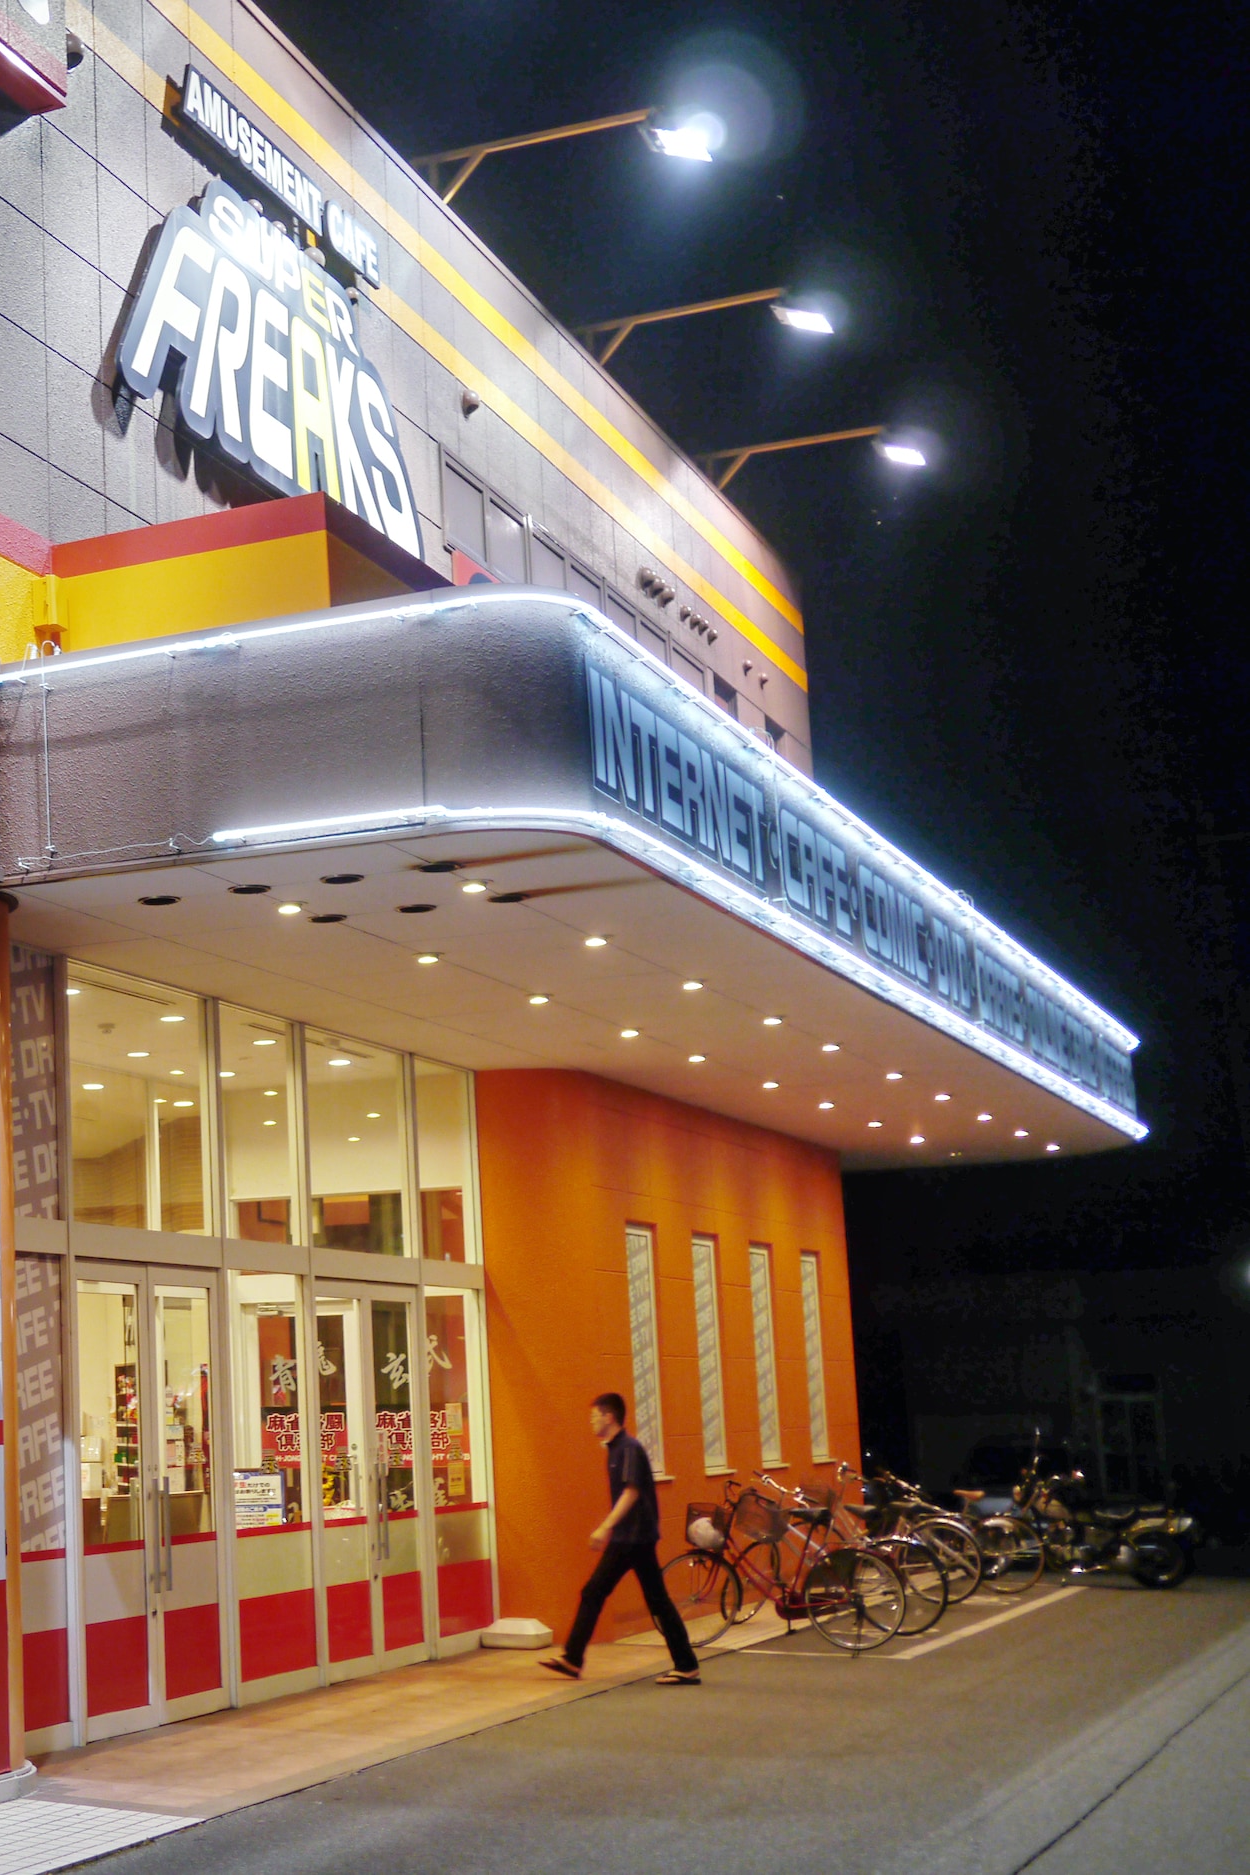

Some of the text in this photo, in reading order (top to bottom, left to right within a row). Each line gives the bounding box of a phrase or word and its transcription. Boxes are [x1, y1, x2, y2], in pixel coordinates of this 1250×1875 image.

[186, 70, 380, 284] AMUSEMENT CAFE
[209, 195, 359, 357] SUPER
[131, 226, 424, 560] FREAKS
[588, 665, 766, 886] INTERNET
[779, 805, 853, 938] CAFE
